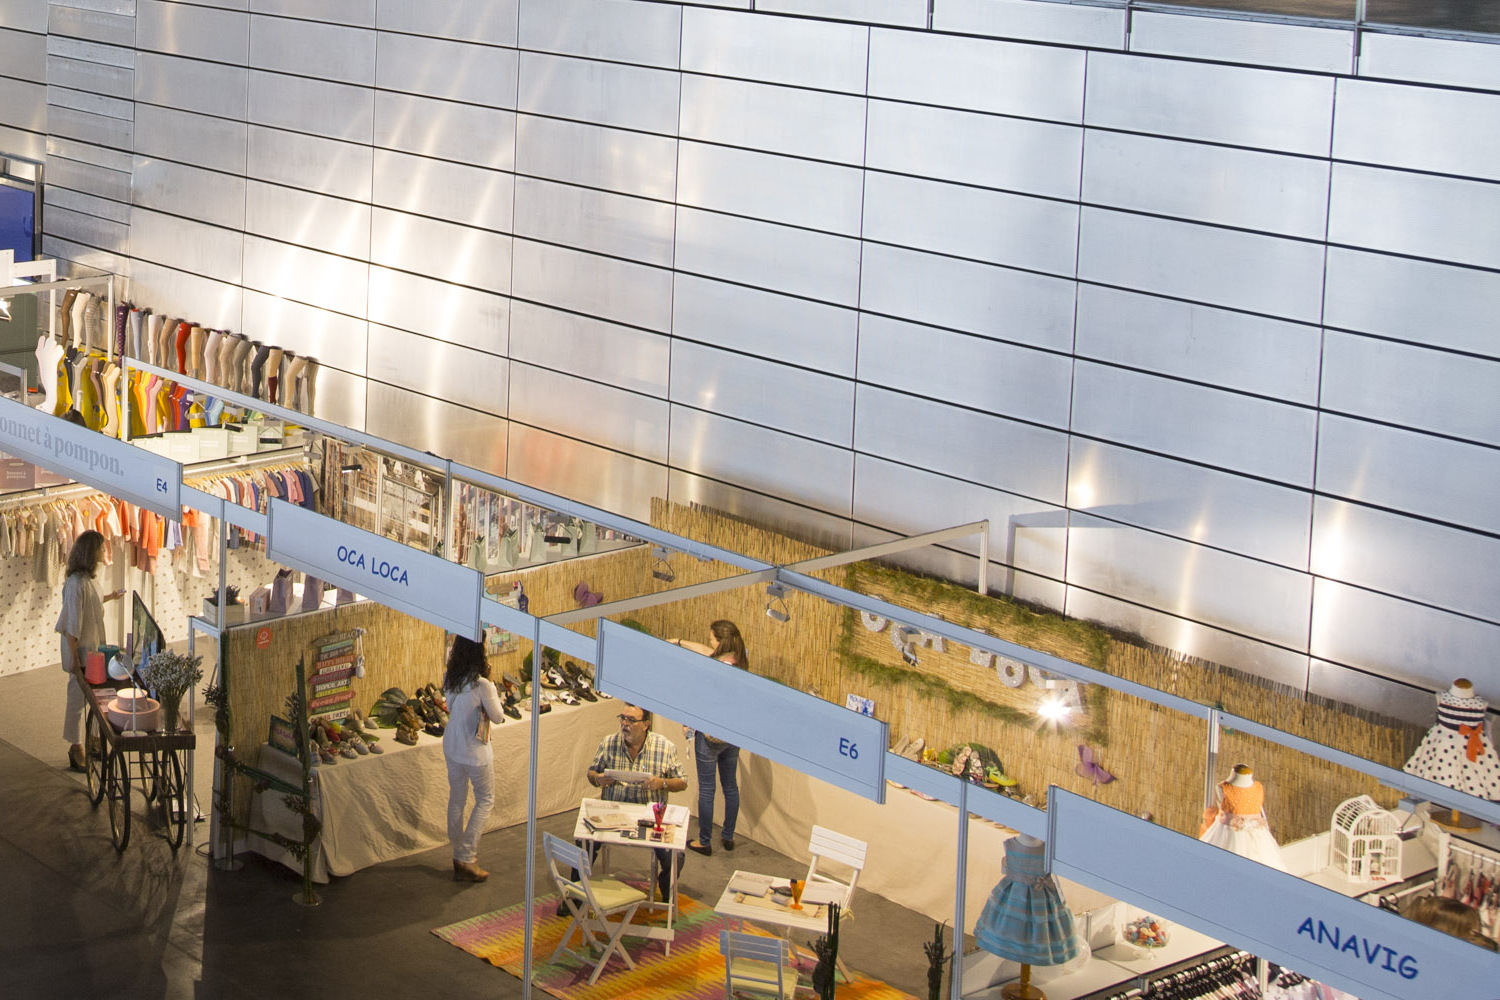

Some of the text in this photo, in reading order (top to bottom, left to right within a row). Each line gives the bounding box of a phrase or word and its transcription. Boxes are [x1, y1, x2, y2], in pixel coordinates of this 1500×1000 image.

[44, 427, 53, 450] à
[54, 437, 125, 477] pompon.
[156, 478, 168, 494] E4
[337, 546, 409, 586] OCA LOCA
[839, 736, 859, 760] E6
[1297, 916, 1419, 980] ANAVIG
